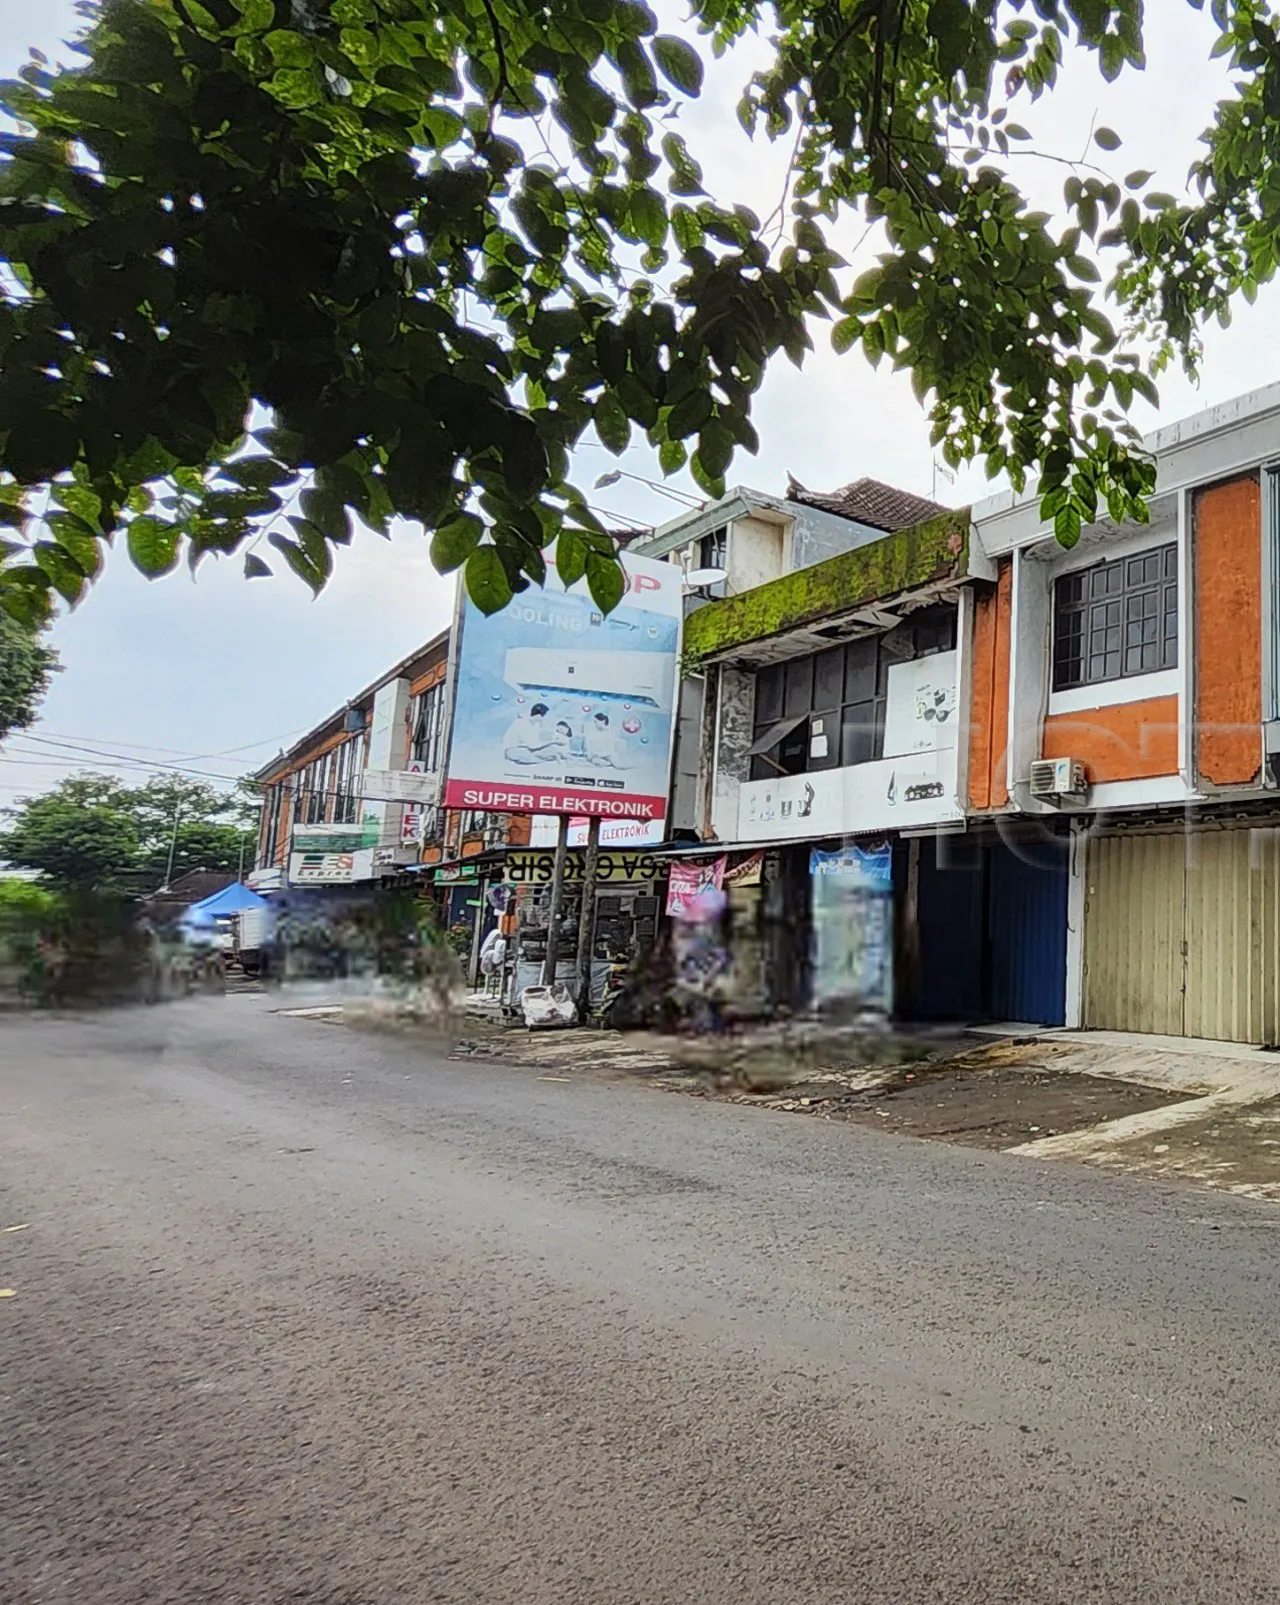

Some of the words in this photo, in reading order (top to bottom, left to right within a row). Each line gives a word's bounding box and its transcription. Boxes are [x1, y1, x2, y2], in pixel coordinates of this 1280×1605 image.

[463, 790, 534, 809] SUPER
[538, 795, 653, 817] ELEKTRONIK
[602, 824, 650, 840] ELEKTRONIK
